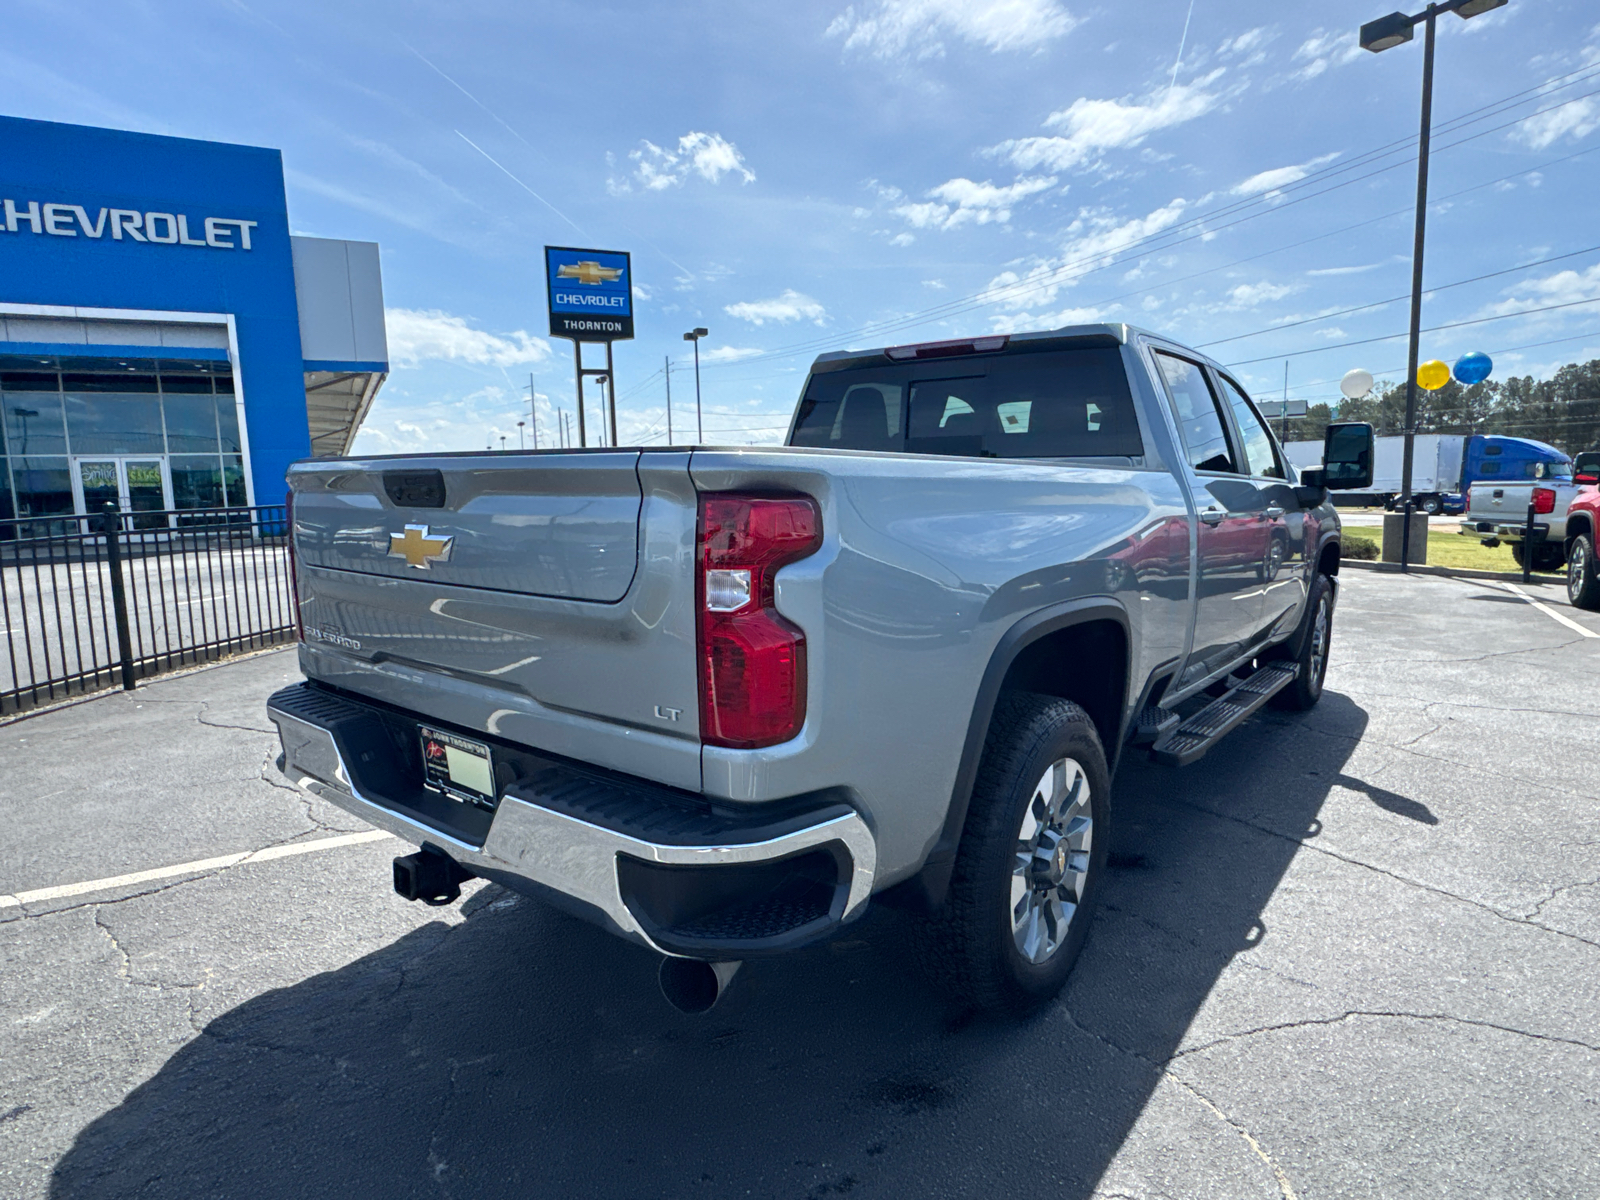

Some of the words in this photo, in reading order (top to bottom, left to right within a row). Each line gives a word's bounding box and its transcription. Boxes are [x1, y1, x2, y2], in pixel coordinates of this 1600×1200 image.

[0, 199, 258, 250] HEVROLET
[556, 293, 625, 307] CHEVROLET
[563, 320, 622, 331] THORNTON
[654, 704, 682, 722] LT
